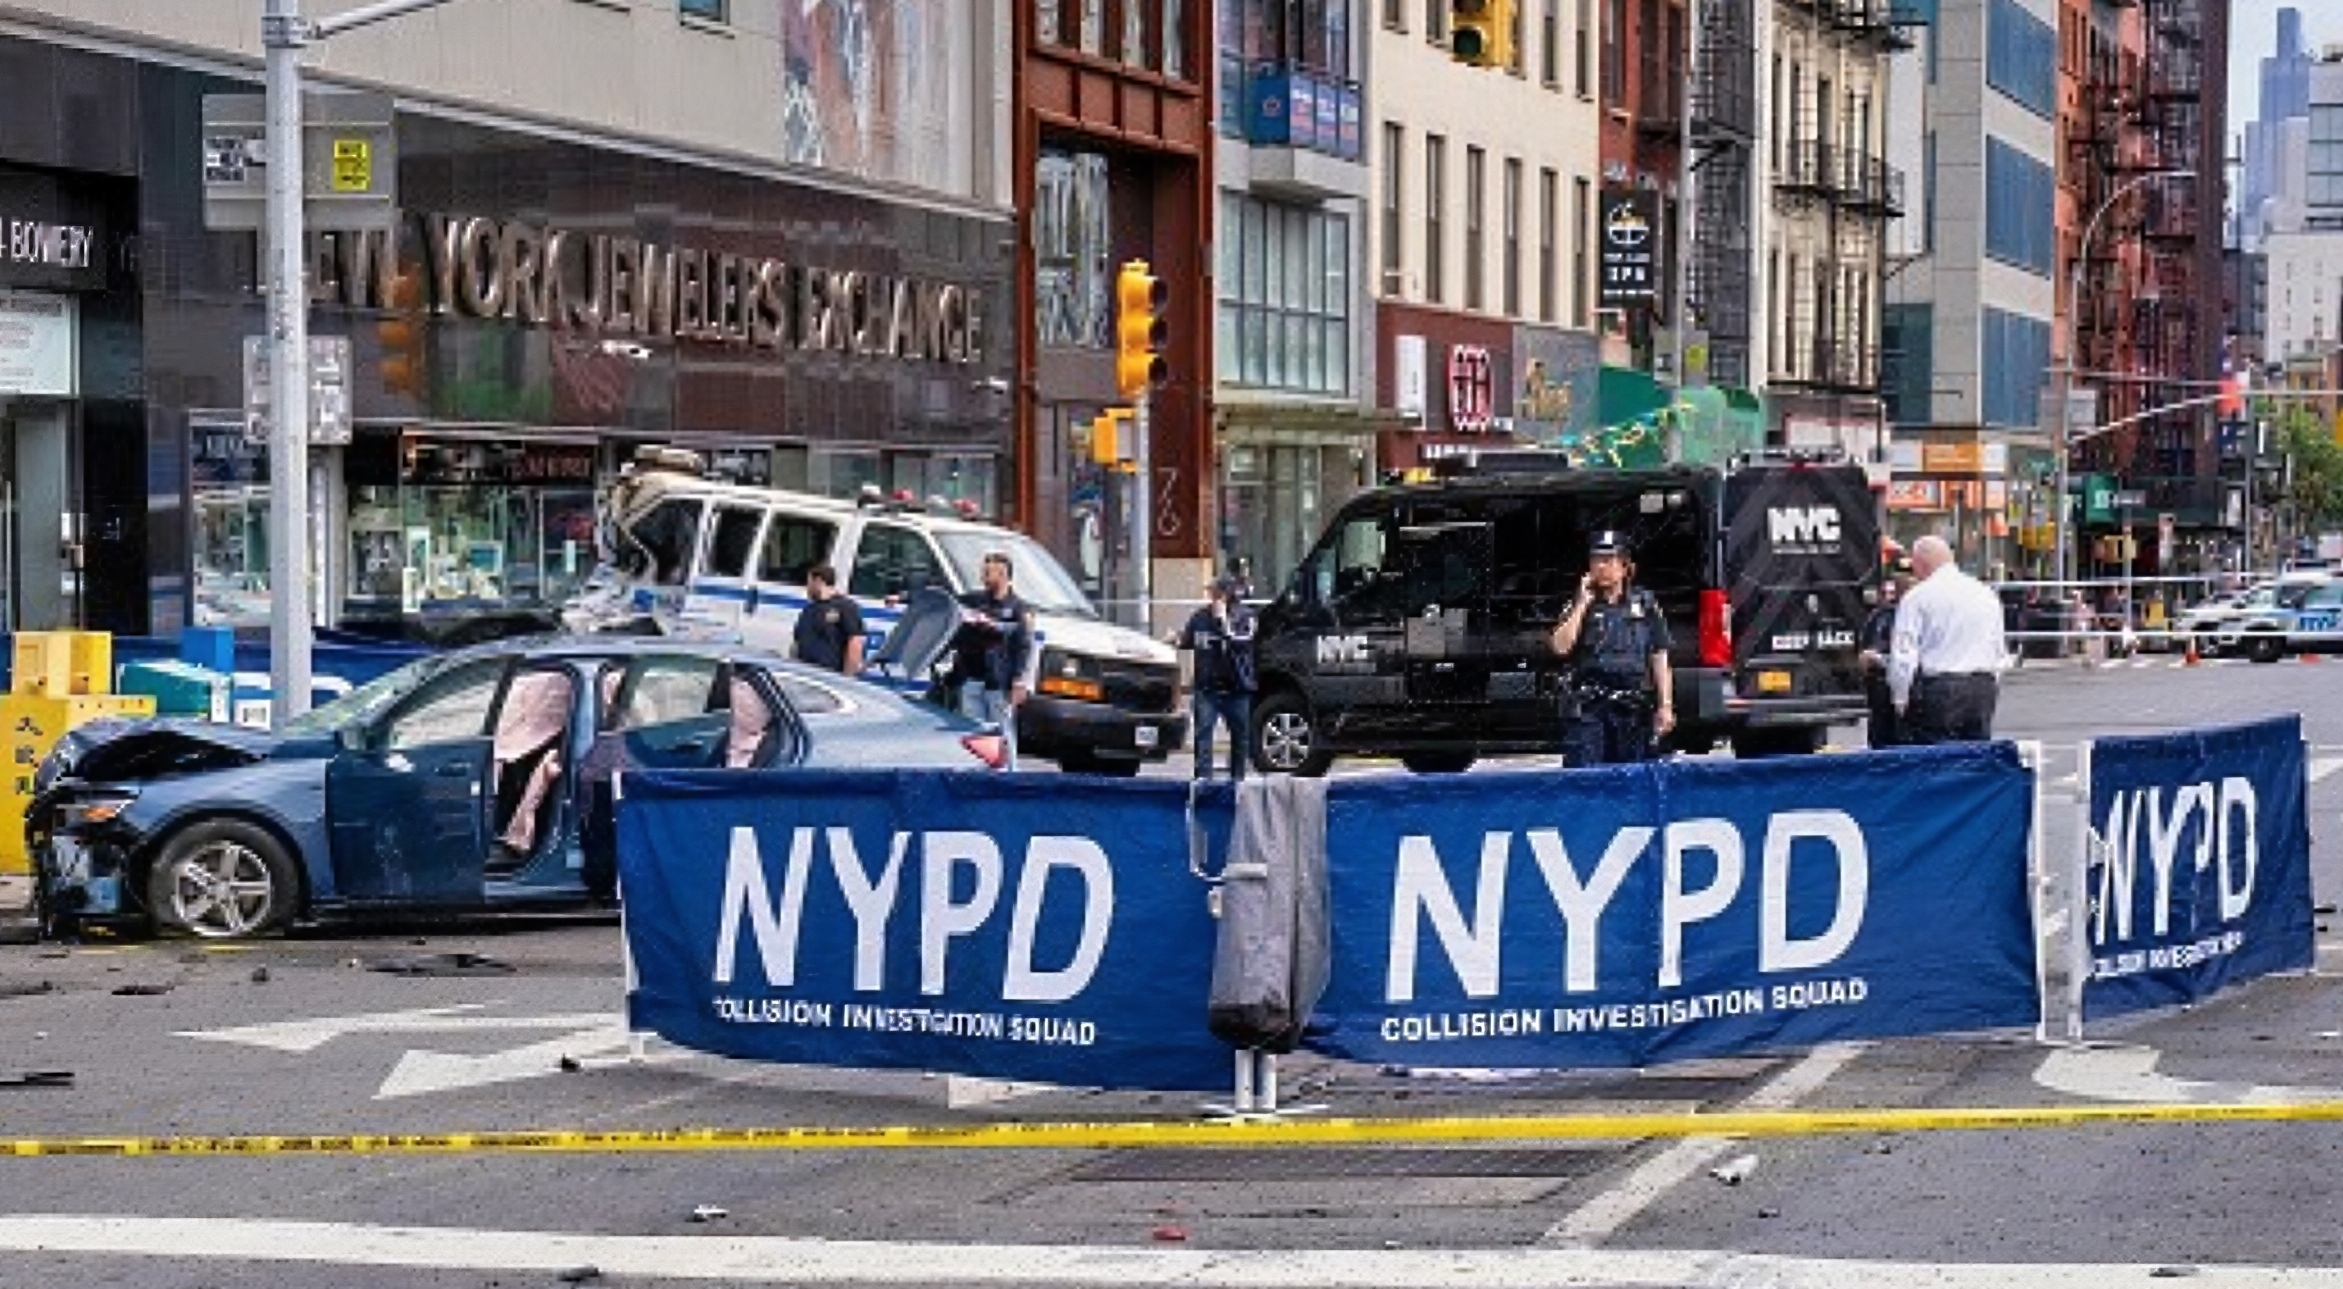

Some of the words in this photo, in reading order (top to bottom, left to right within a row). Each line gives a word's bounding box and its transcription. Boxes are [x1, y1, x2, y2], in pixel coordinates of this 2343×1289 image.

[424, 212, 567, 322] YORK
[572, 232, 787, 347] JEWELERS
[799, 266, 981, 362] EXCHANGE
[1767, 506, 1841, 542] NYC
[1317, 635, 1369, 663] NYC
[710, 826, 1115, 1003] NYPD
[1384, 806, 1871, 1003] NYPD
[1007, 1013, 1096, 1046] SQUAD
[1381, 1008, 1541, 1042] COLLISION
[1553, 989, 1764, 1033] INVESTIGATION
[1772, 977, 1868, 1009] SQUAD
